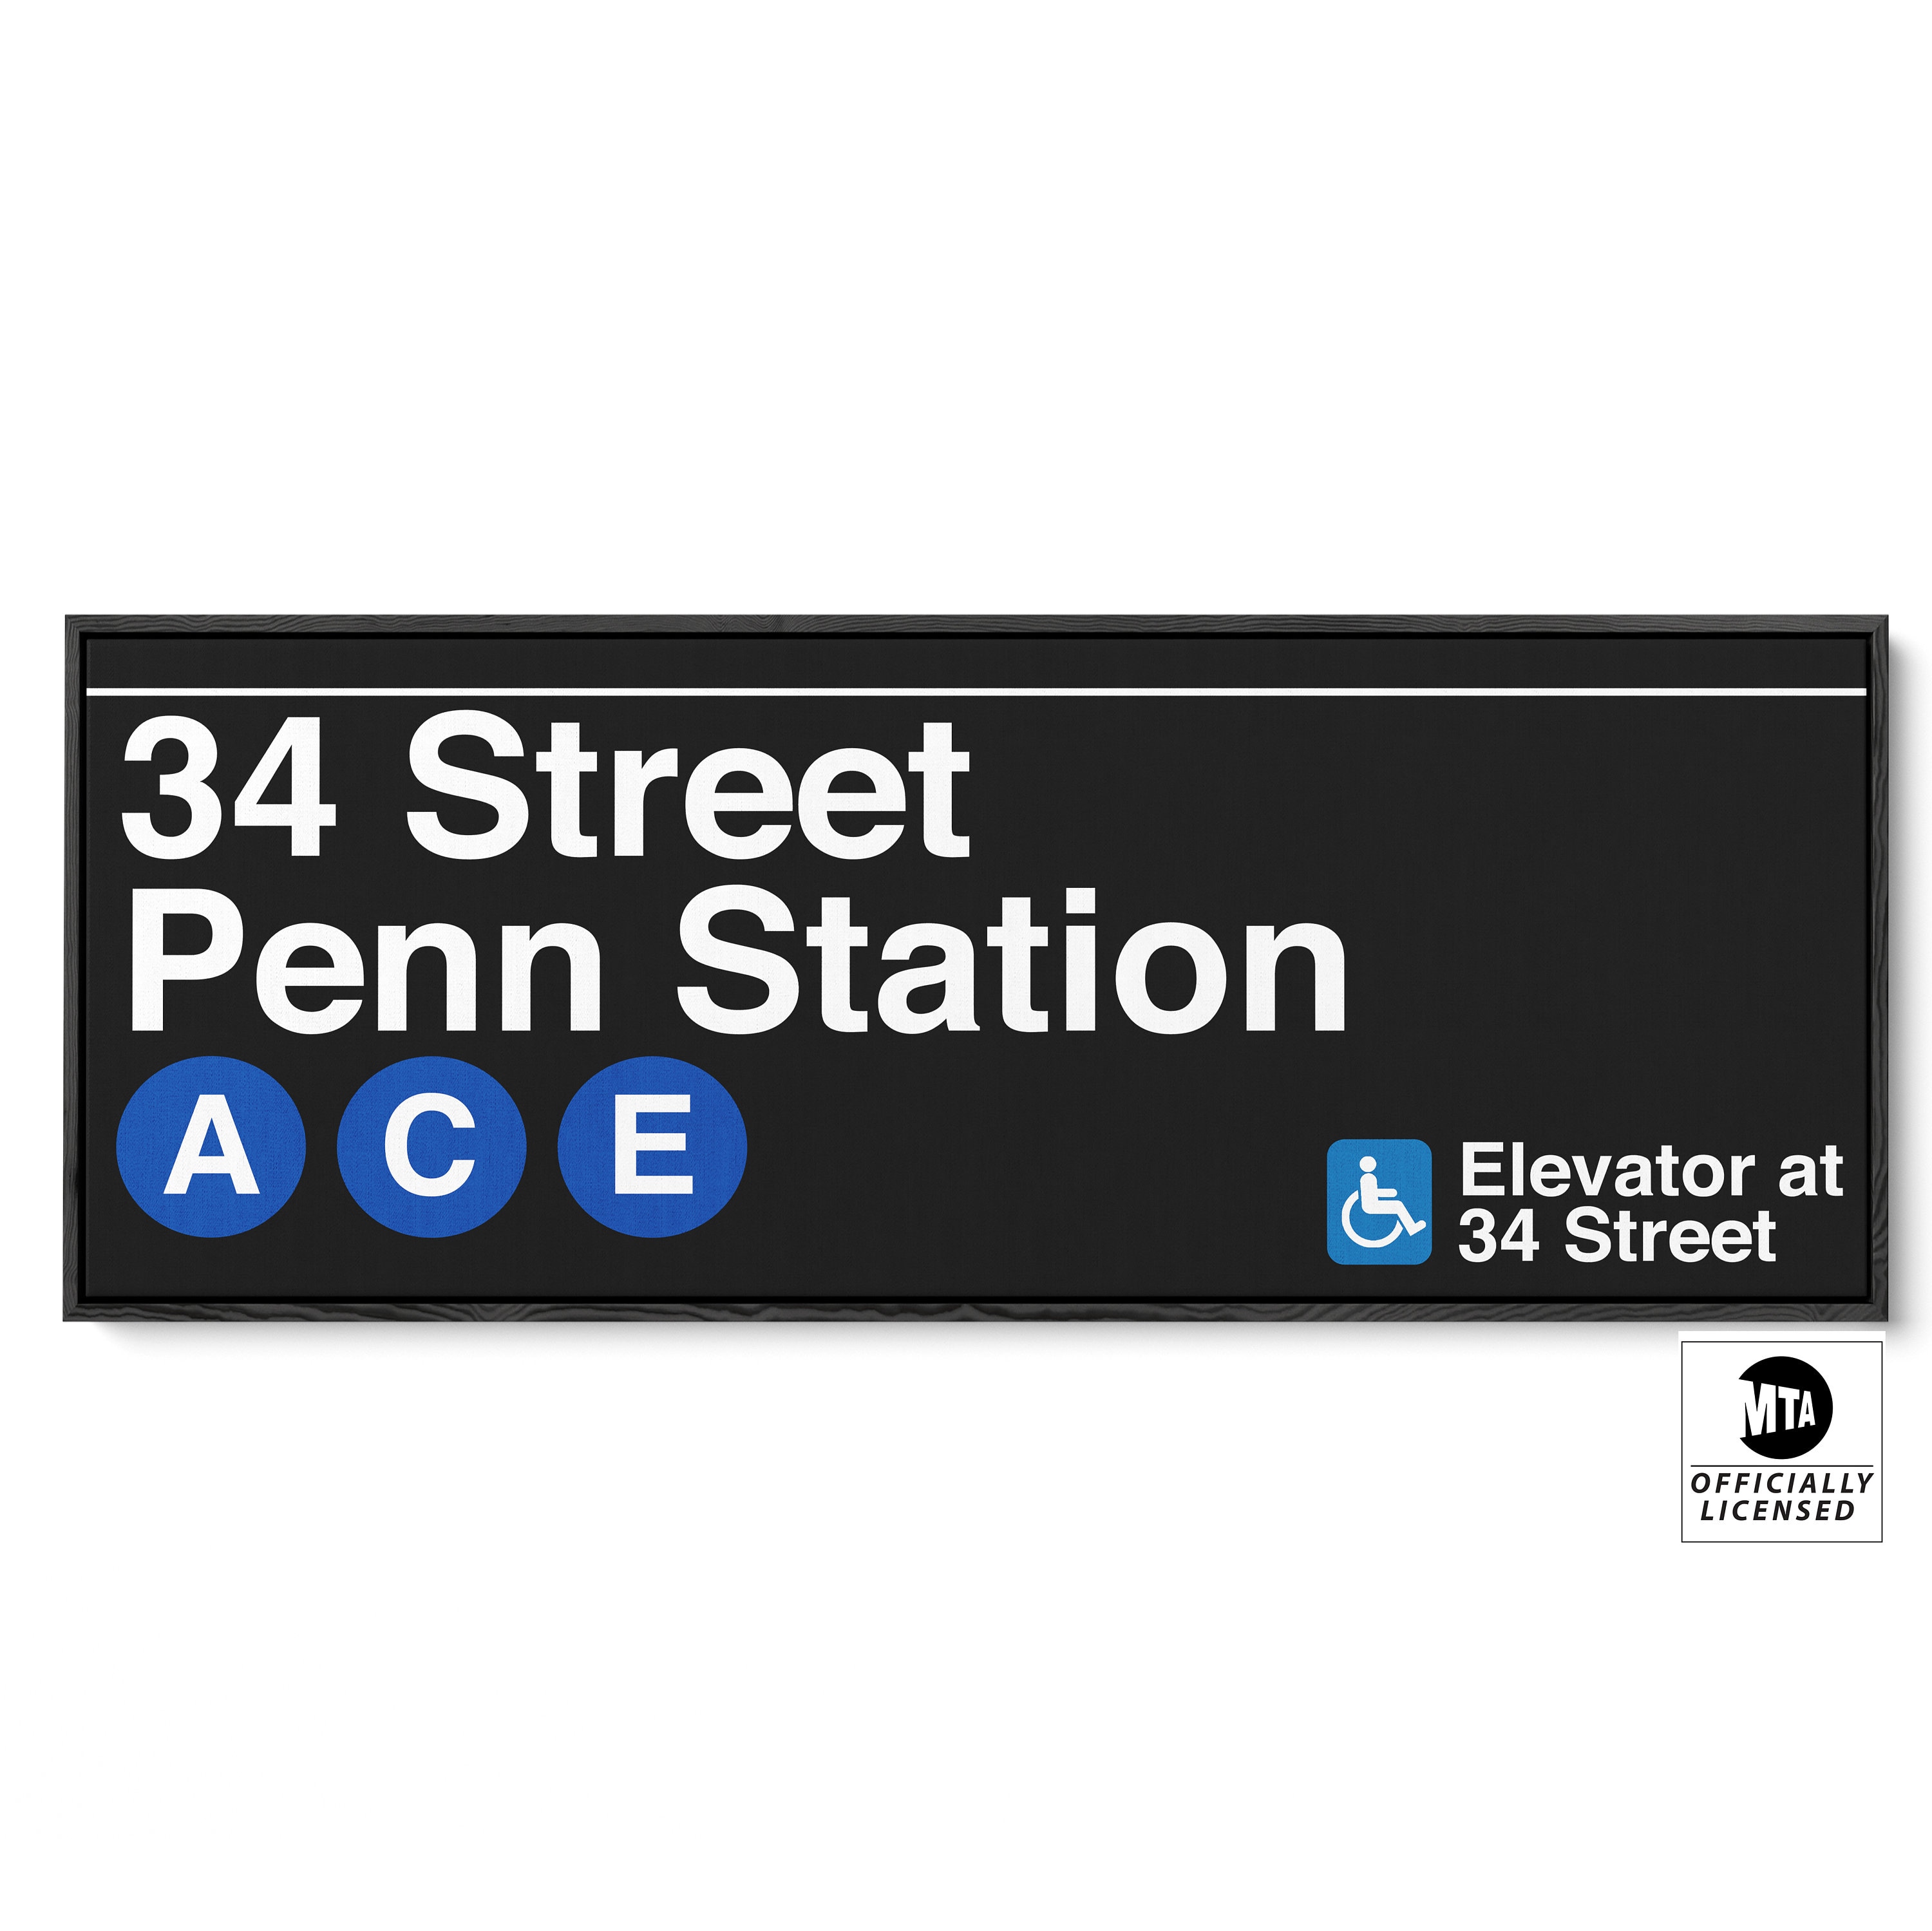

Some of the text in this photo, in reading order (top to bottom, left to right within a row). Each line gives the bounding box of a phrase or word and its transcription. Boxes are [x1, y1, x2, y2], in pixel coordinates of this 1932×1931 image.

[122, 710, 969, 860] 34 Street
[133, 885, 1344, 1034] Penn Station
[164, 1093, 693, 1196] A C E
[1463, 1142, 1843, 1196] Elevator at
[1459, 1206, 1776, 1262] 34 Street
